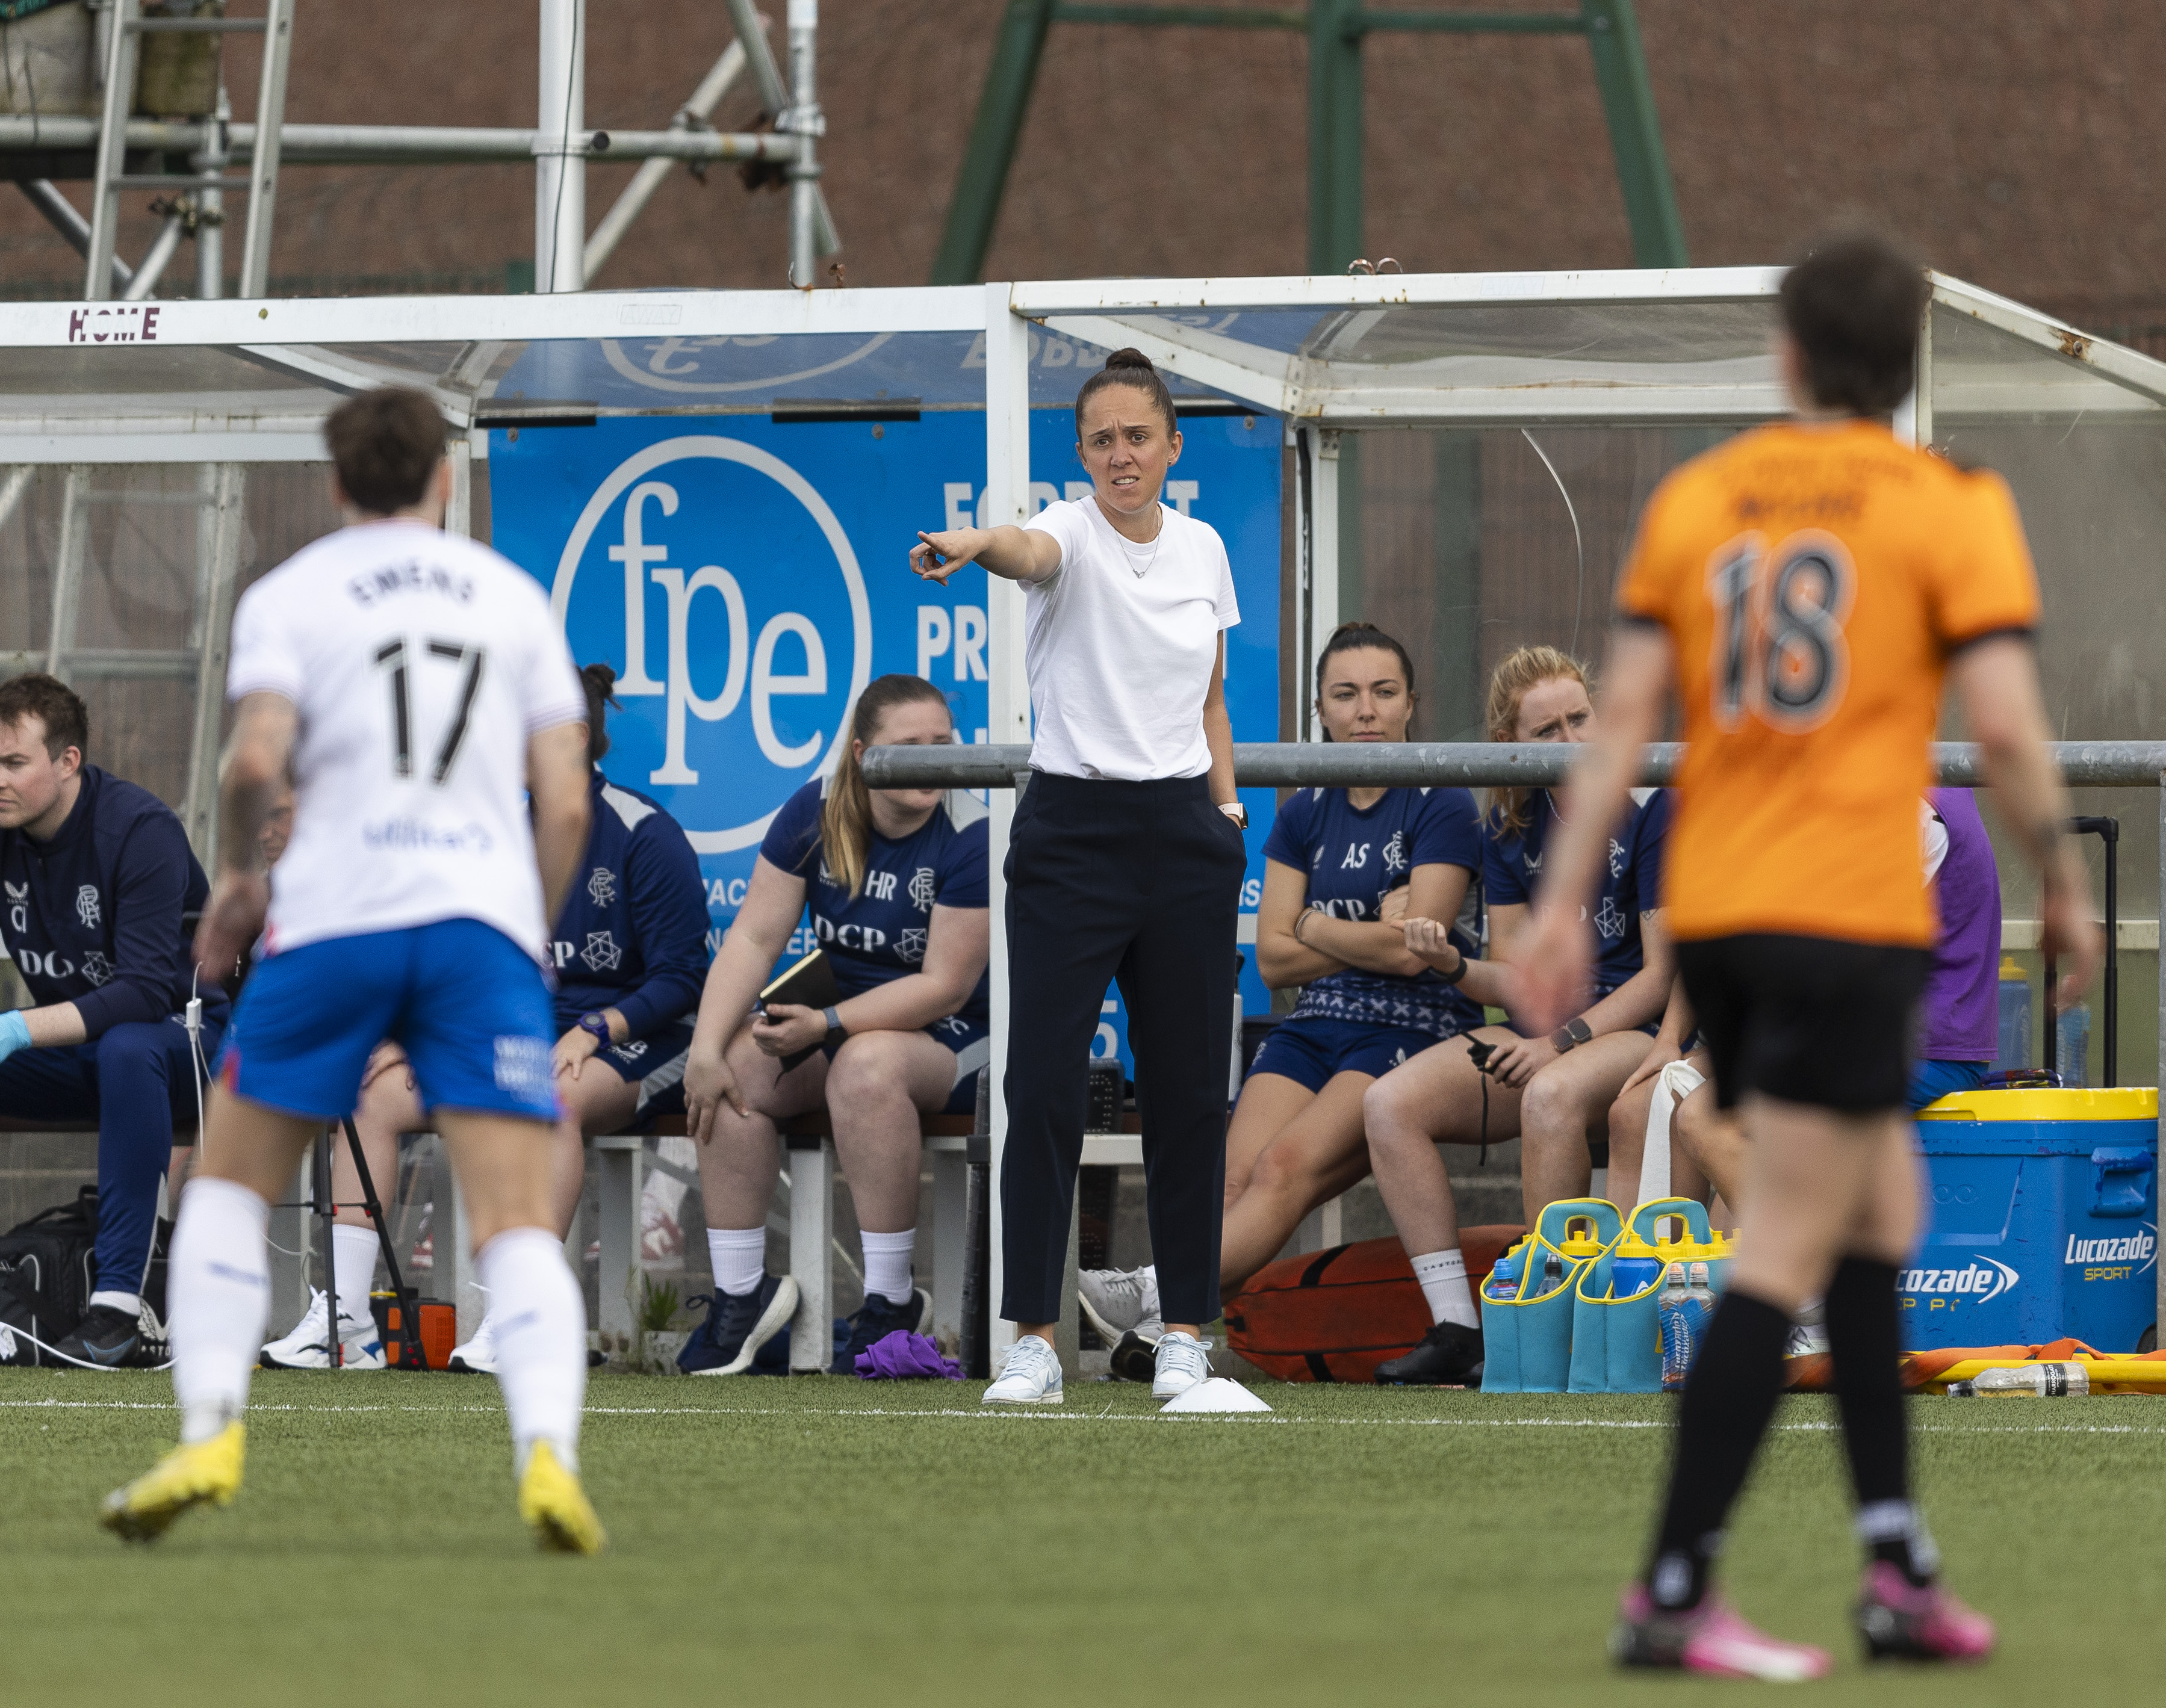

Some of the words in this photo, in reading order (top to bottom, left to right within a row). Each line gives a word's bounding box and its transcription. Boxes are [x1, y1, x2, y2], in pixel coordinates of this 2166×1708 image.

[608, 480, 828, 785] fpe
[1705, 530, 1858, 735] 18
[370, 638, 485, 785] 17
[1340, 843, 1371, 870] AS
[864, 870, 898, 902] HR
[815, 914, 886, 952] DCP
[2065, 1230, 2154, 1264] Lucozade
[2084, 1266, 2132, 1281] SPORT
